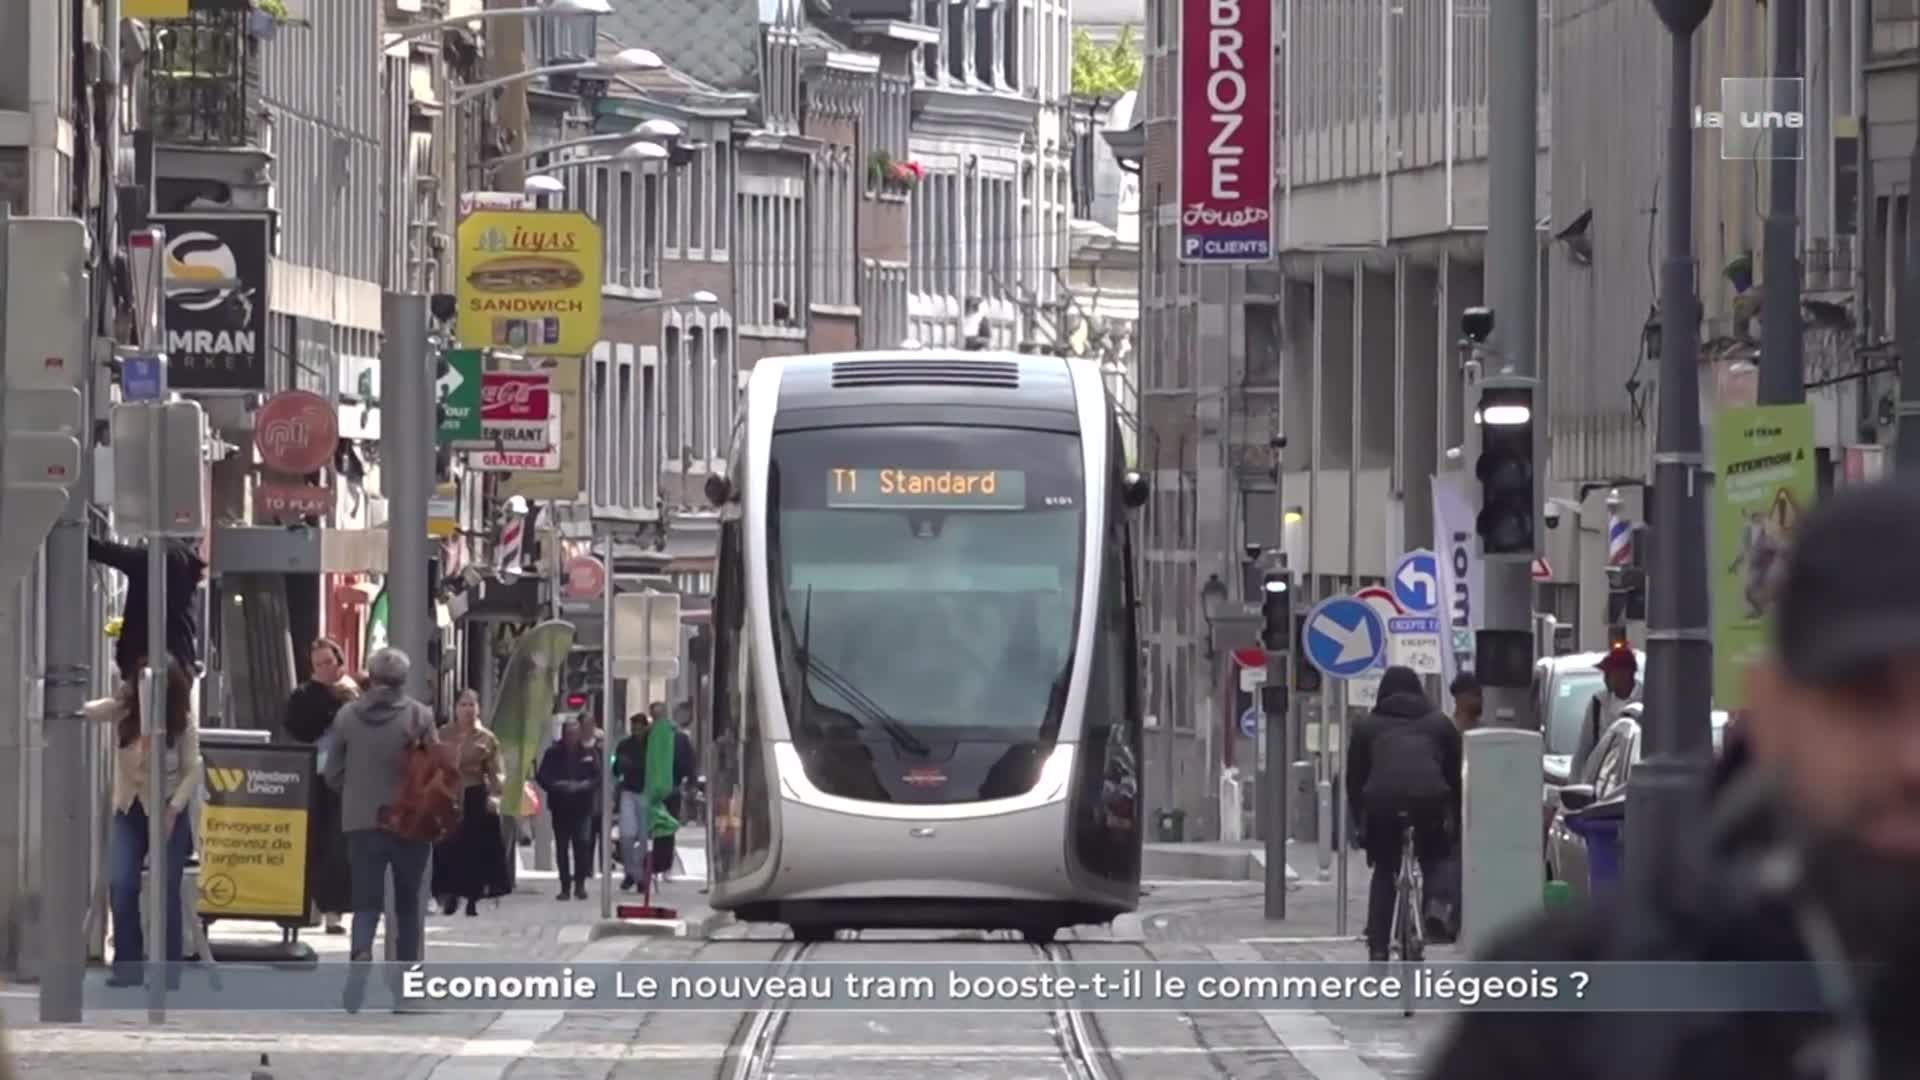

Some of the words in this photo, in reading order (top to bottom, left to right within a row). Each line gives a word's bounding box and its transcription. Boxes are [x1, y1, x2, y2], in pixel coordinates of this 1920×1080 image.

[1183, 202, 1268, 227] Jouets
[1204, 240, 1267, 254] CLIENTS
[470, 299, 583, 313] SANDWICH
[163, 330, 256, 355] MRAN
[1726, 451, 1792, 476] ATTENTION
[832, 468, 858, 494] T1
[880, 468, 997, 495] Standard
[266, 499, 285, 511] TO
[289, 499, 325, 511] PLAY
[246, 769, 300, 784] Western
[246, 783, 286, 795] Union
[207, 817, 271, 835] Envoyez
[274, 822, 291, 833] et
[271, 837, 293, 849] de
[265, 853, 286, 866] ici
